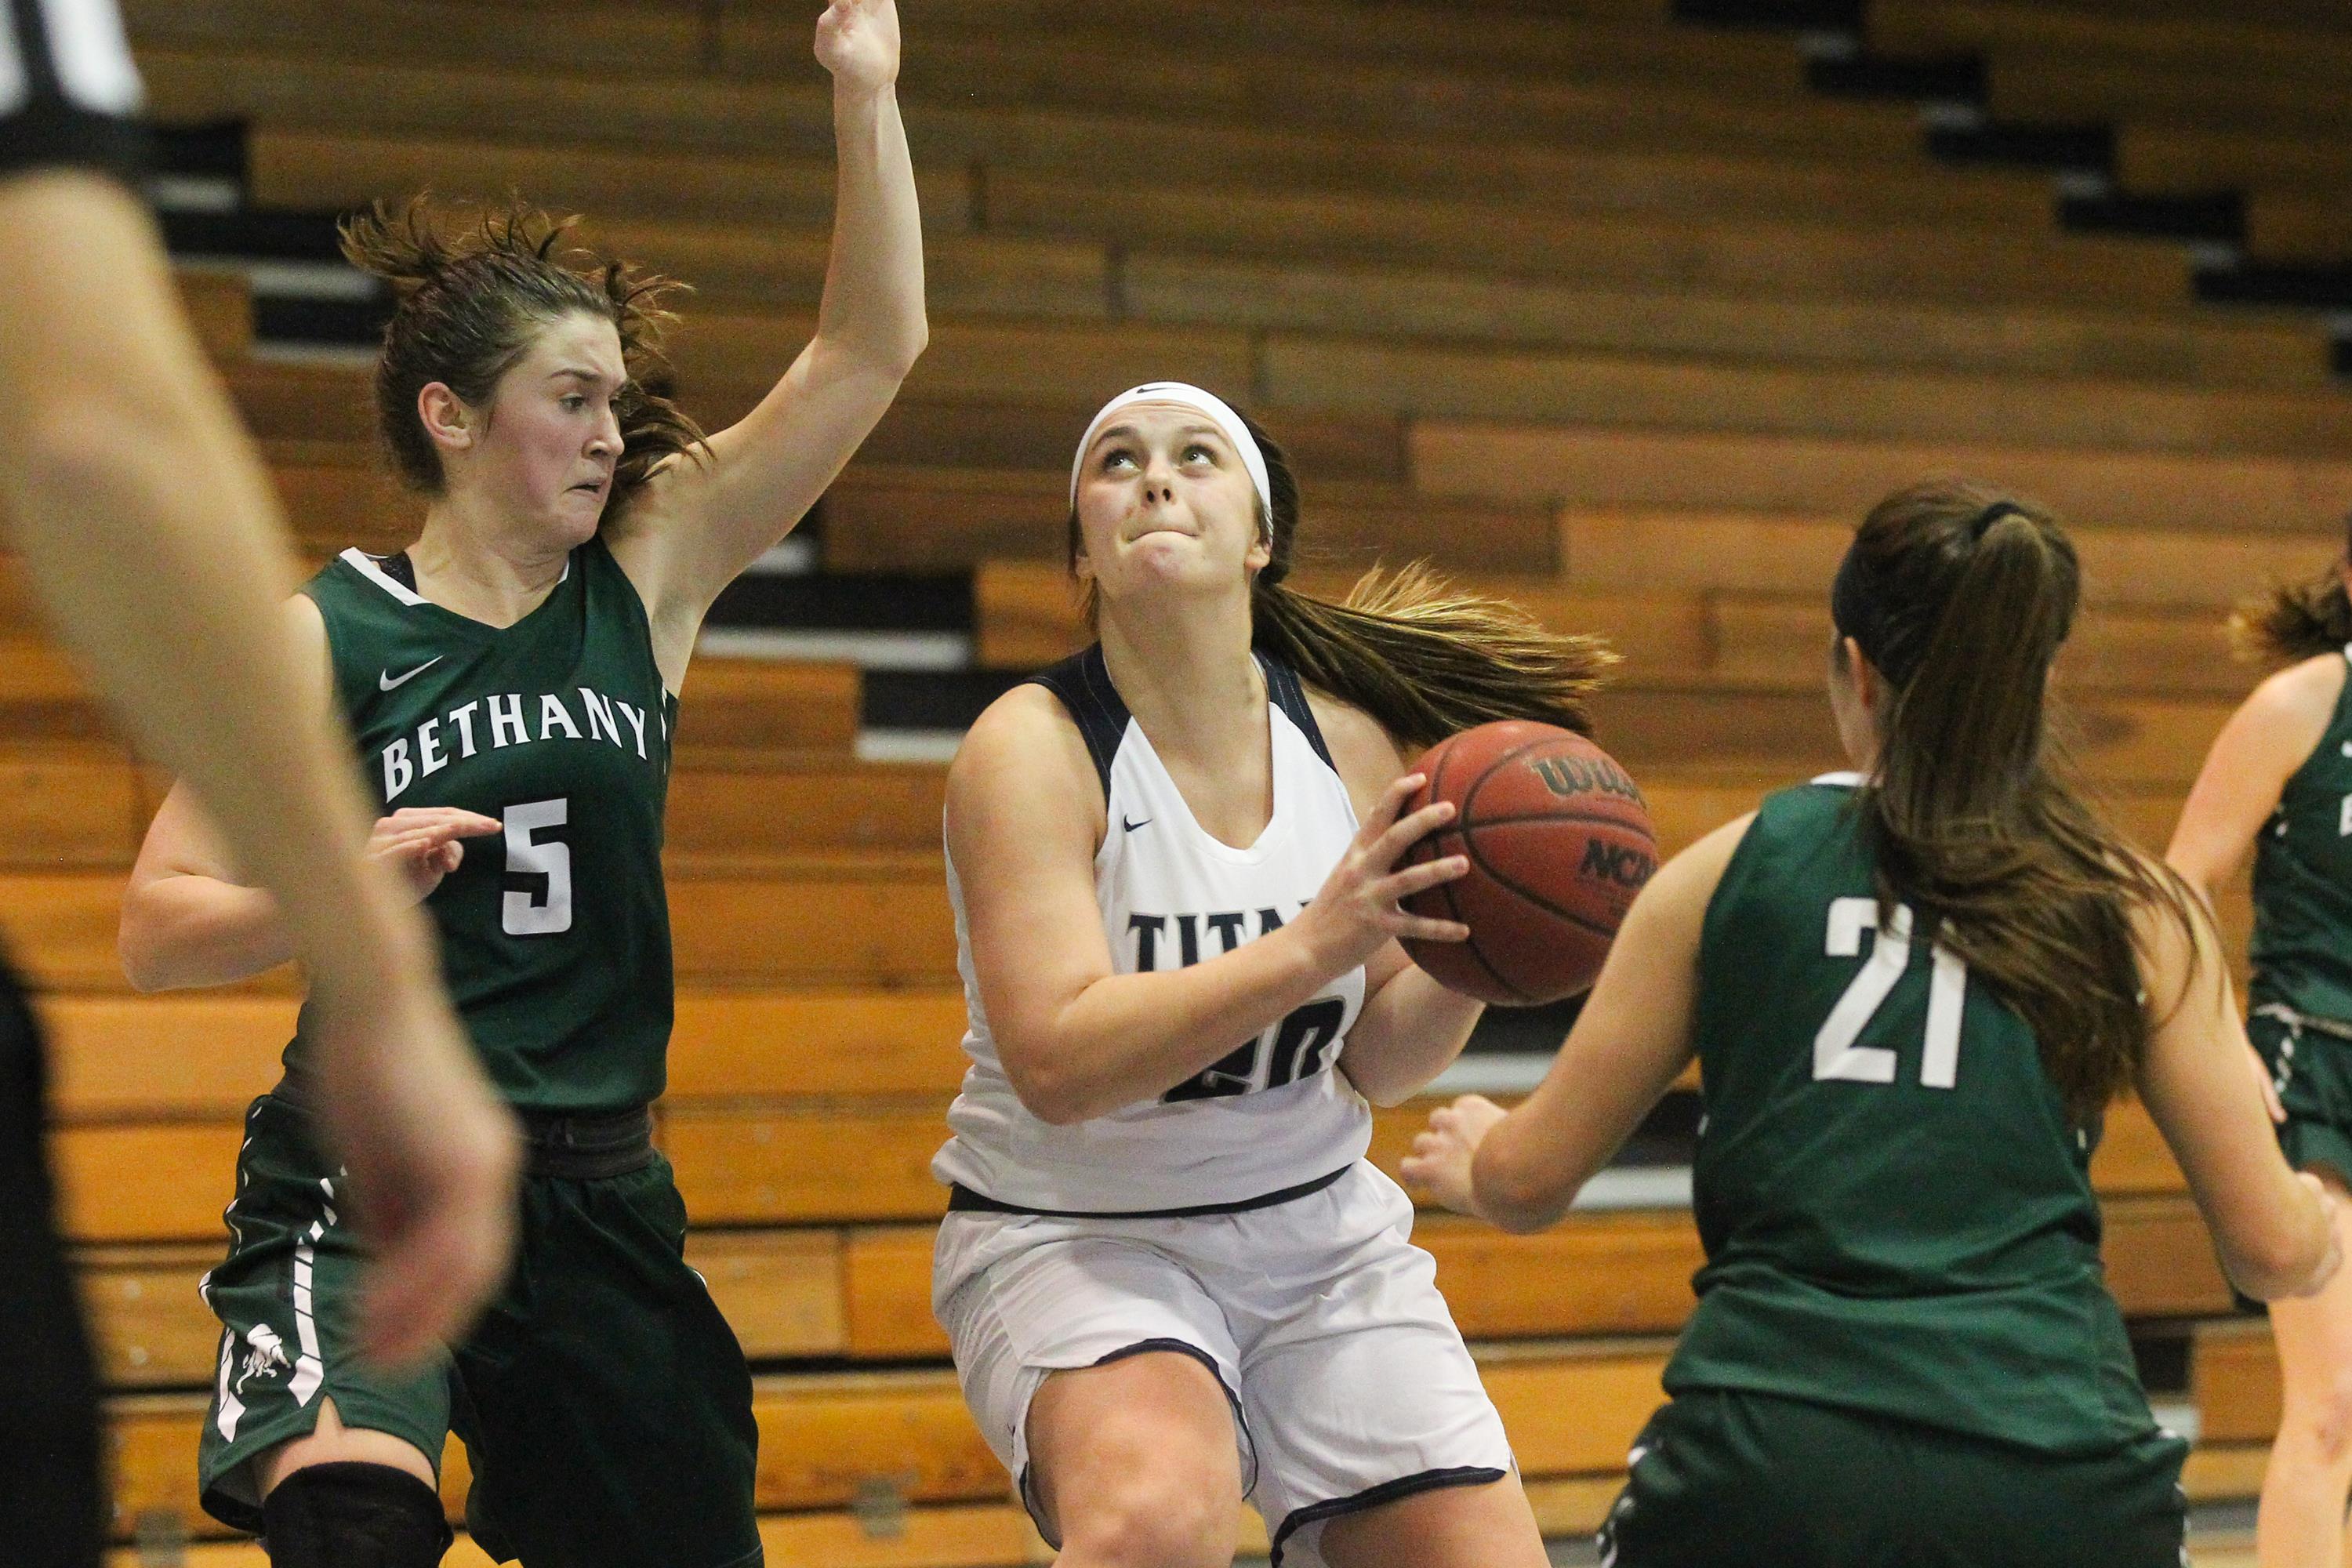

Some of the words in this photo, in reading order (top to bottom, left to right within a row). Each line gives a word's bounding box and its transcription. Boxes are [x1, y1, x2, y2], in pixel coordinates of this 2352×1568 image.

[382, 687, 648, 804] BETHANY
[502, 798, 572, 935] 5
[1812, 896, 1966, 1089] 21
